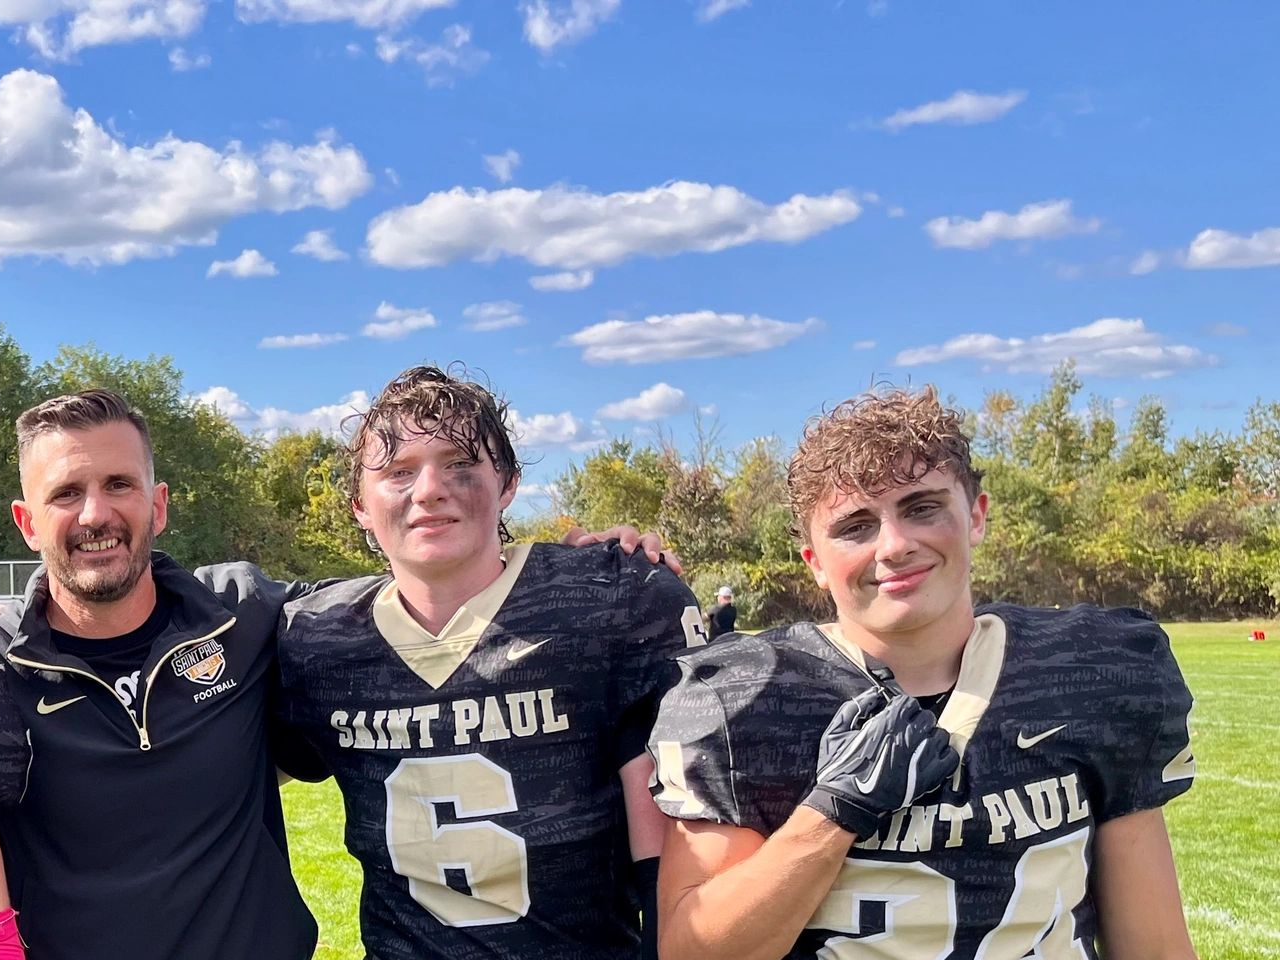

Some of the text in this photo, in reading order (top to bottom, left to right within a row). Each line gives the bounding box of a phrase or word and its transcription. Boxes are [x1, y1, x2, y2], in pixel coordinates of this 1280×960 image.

[175, 640, 223, 673] SAINT PAUL
[193, 678, 237, 704] FOOTBALL
[331, 688, 570, 749] SAINT PAUL
[384, 752, 532, 928] 6
[852, 772, 1090, 852] INT PAUL
